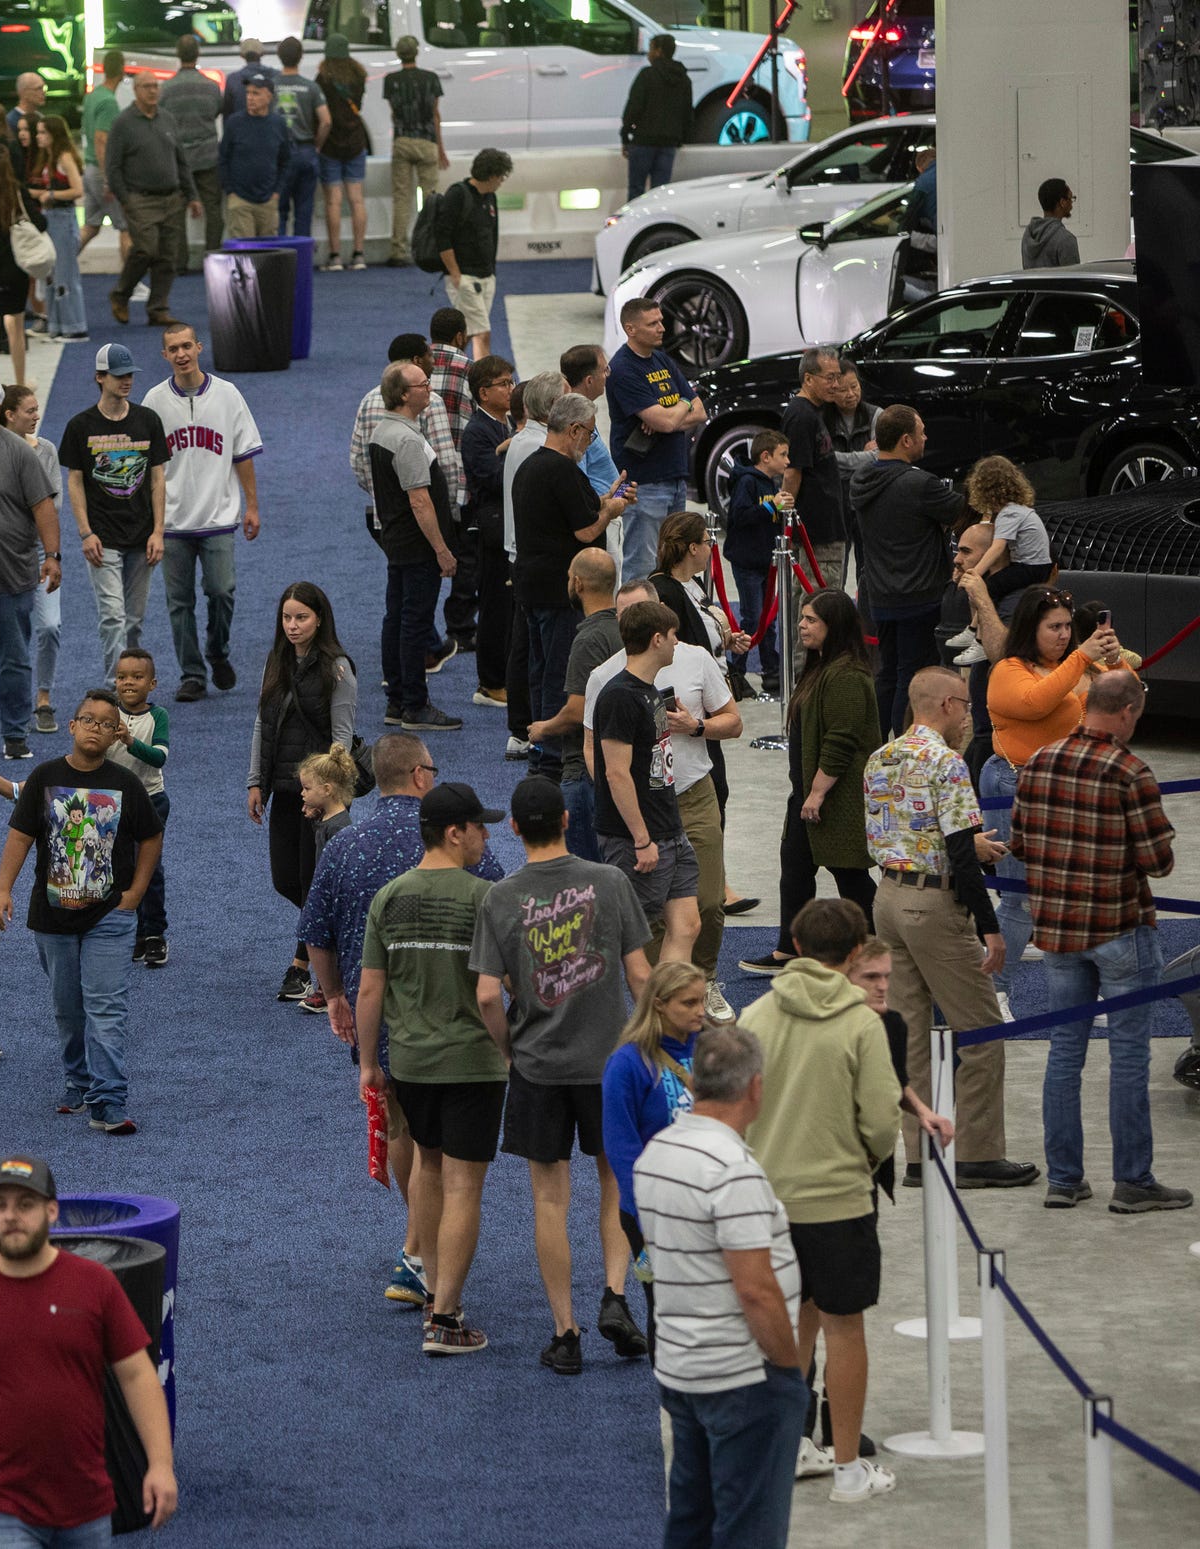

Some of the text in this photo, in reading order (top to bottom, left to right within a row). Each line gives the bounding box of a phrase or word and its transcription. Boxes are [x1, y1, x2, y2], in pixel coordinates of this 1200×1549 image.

[166, 426, 223, 457] PISTONS
[60, 888, 99, 899] HUNTER
[522, 893, 564, 926] Look
[529, 912, 583, 951] Ways
